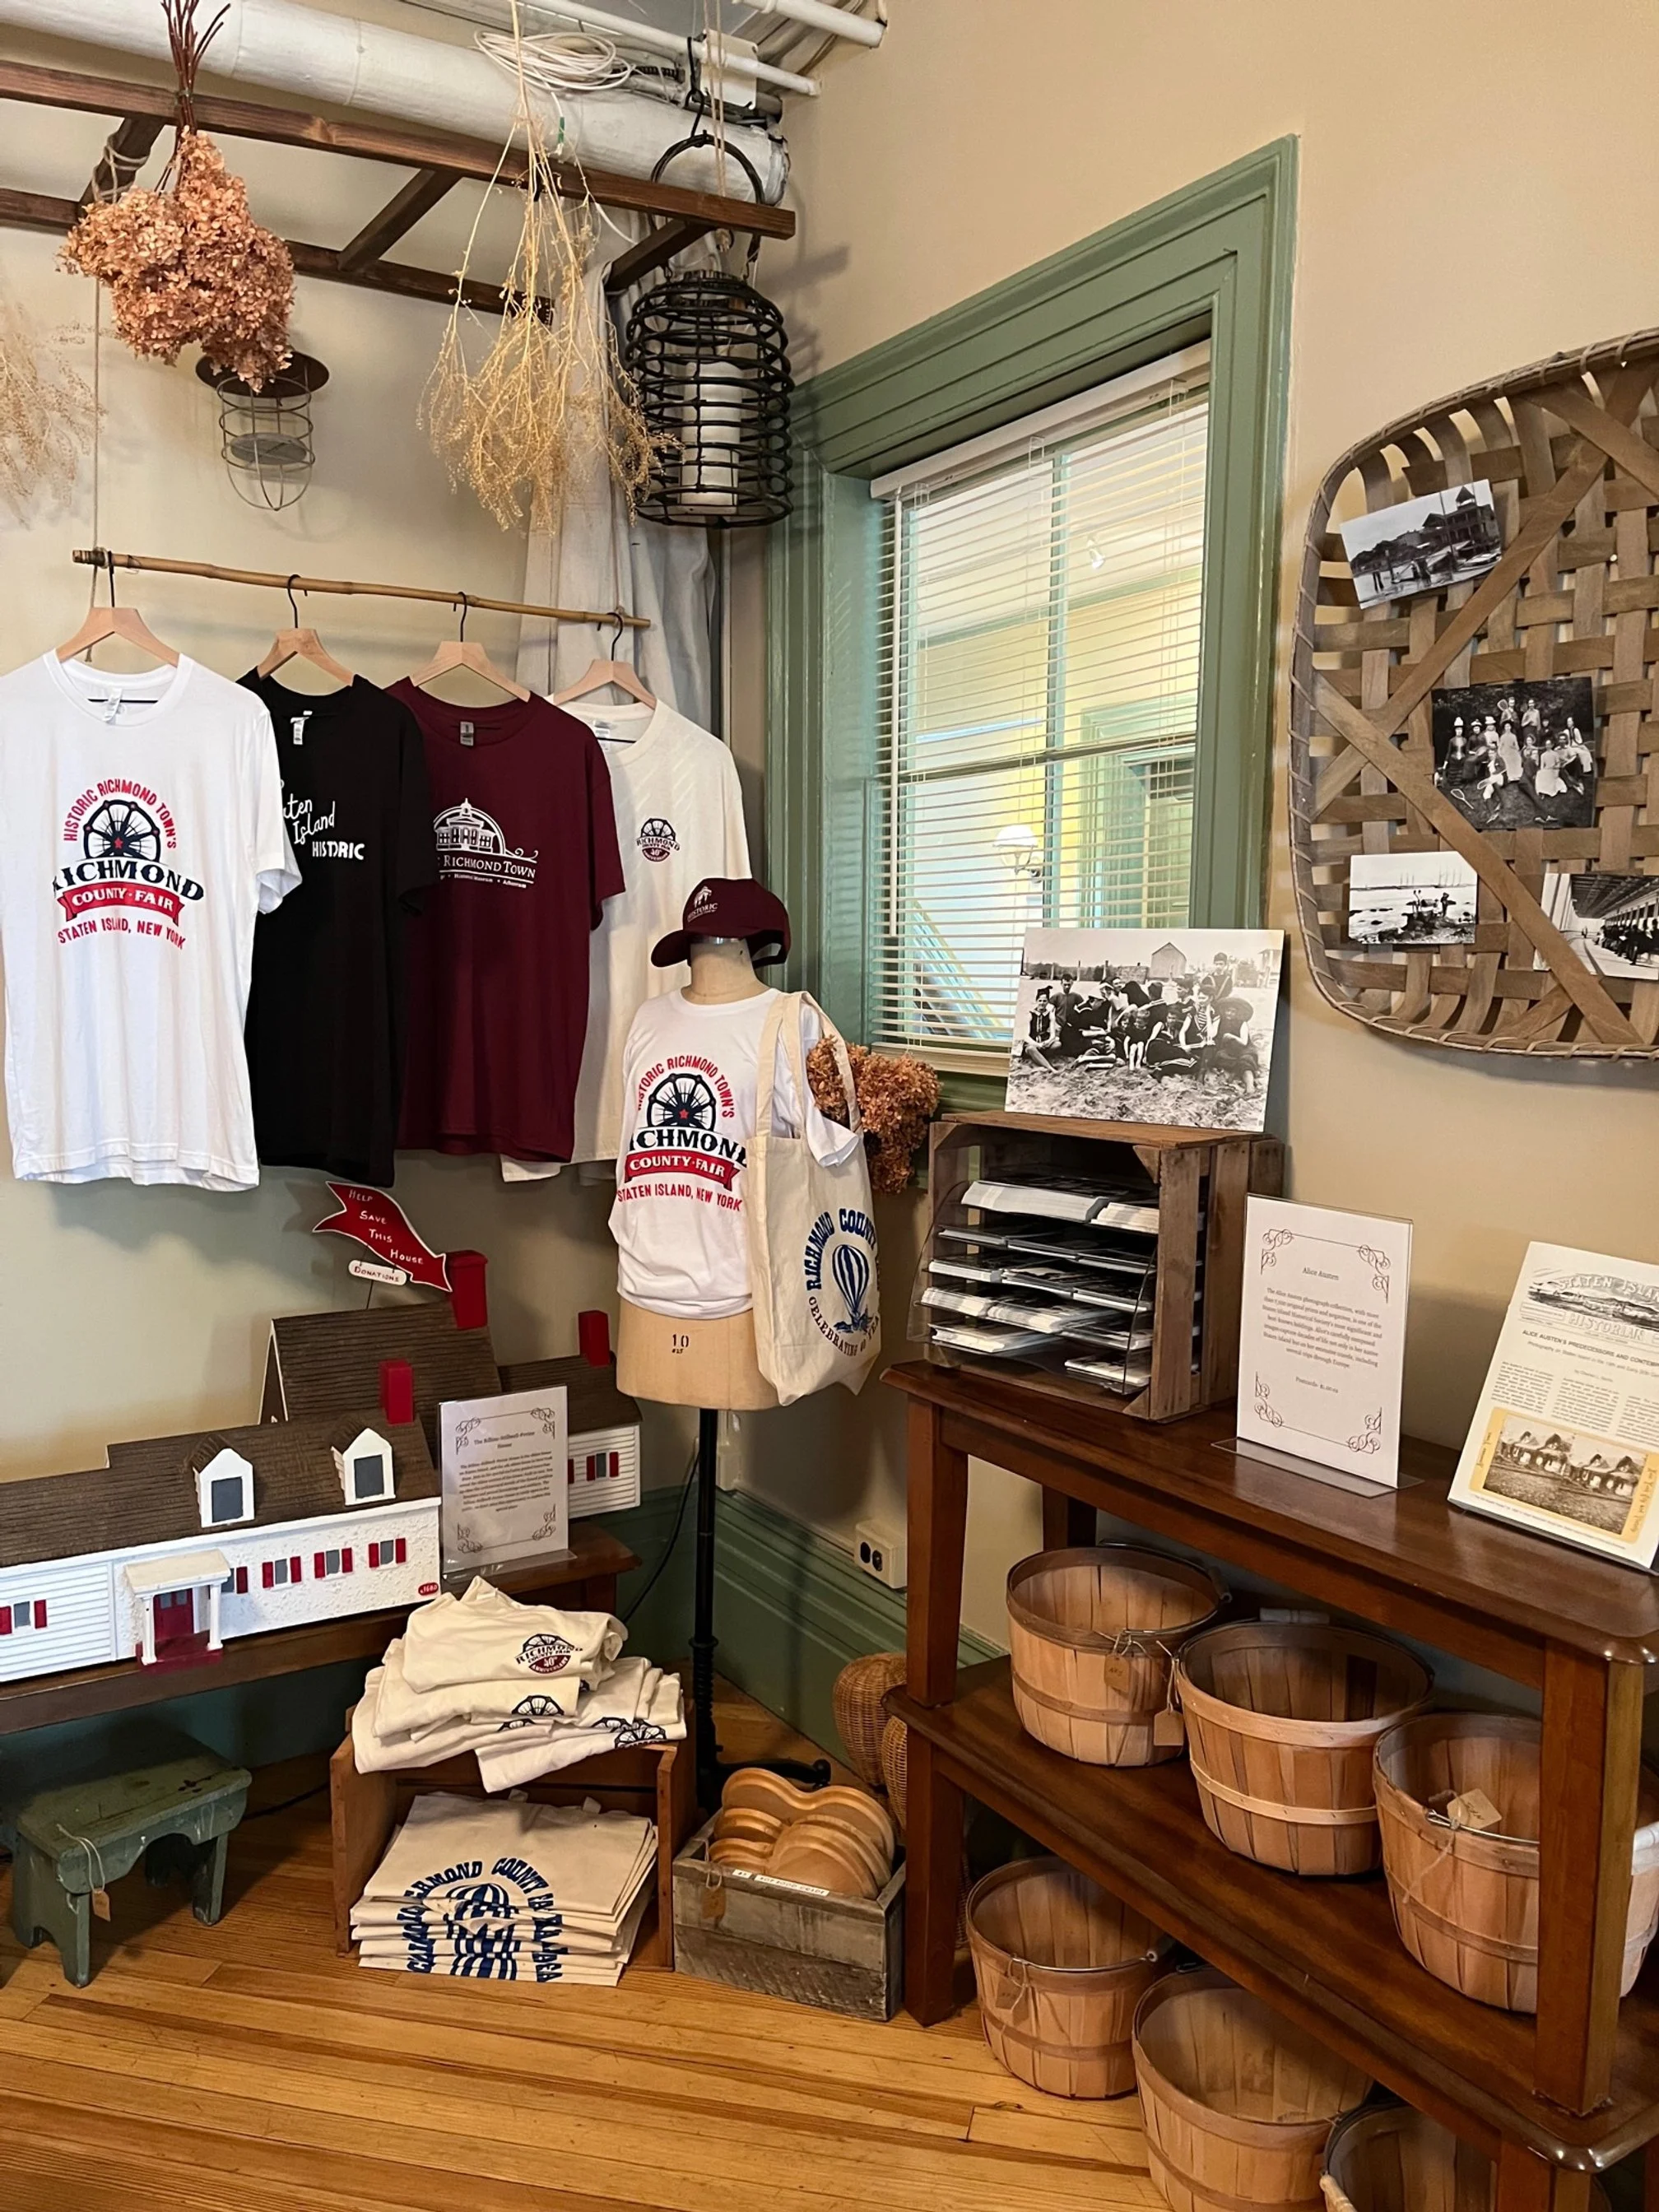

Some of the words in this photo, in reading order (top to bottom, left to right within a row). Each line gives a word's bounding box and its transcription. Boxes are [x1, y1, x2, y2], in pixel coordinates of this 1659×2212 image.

[63, 789, 98, 841] HISTORIC
[96, 778, 157, 806] RICHMOND
[156, 802, 177, 849] TOWN'S
[292, 800, 336, 845] Island
[444, 854, 502, 871] RICHMOND
[503, 860, 536, 878] TOWN
[72, 887, 127, 906] COUNTY
[134, 890, 174, 912] FAIR
[58, 920, 97, 943] STATEN
[137, 920, 162, 936] NEW
[166, 926, 186, 950] YORK
[667, 1055, 718, 1078] RICHMOND
[714, 1075, 735, 1118] TOWN'S
[630, 1128, 747, 1168] CHMON
[630, 1155, 692, 1170] COUNTY
[695, 1159, 725, 1177] FAIR
[349, 1189, 373, 1201] HELP
[617, 1184, 652, 1202] STATEN
[654, 1183, 694, 1200] ISLAND,
[696, 1187, 713, 1203] NEW
[716, 1193, 743, 1211] YORK
[360, 1211, 387, 1224] SAVE
[369, 1229, 393, 1243] THIS
[390, 1248, 424, 1265] HOUSE
[804, 1211, 834, 1290] RICHMOND
[354, 1266, 400, 1283] DONATIONS
[1303, 1267, 1317, 1276] Alice
[808, 1296, 858, 1357] CELEBRATING
[672, 1334, 689, 1347] 10
[404, 1861, 483, 1898] HMOND
[491, 1857, 549, 1894] COUNTY
